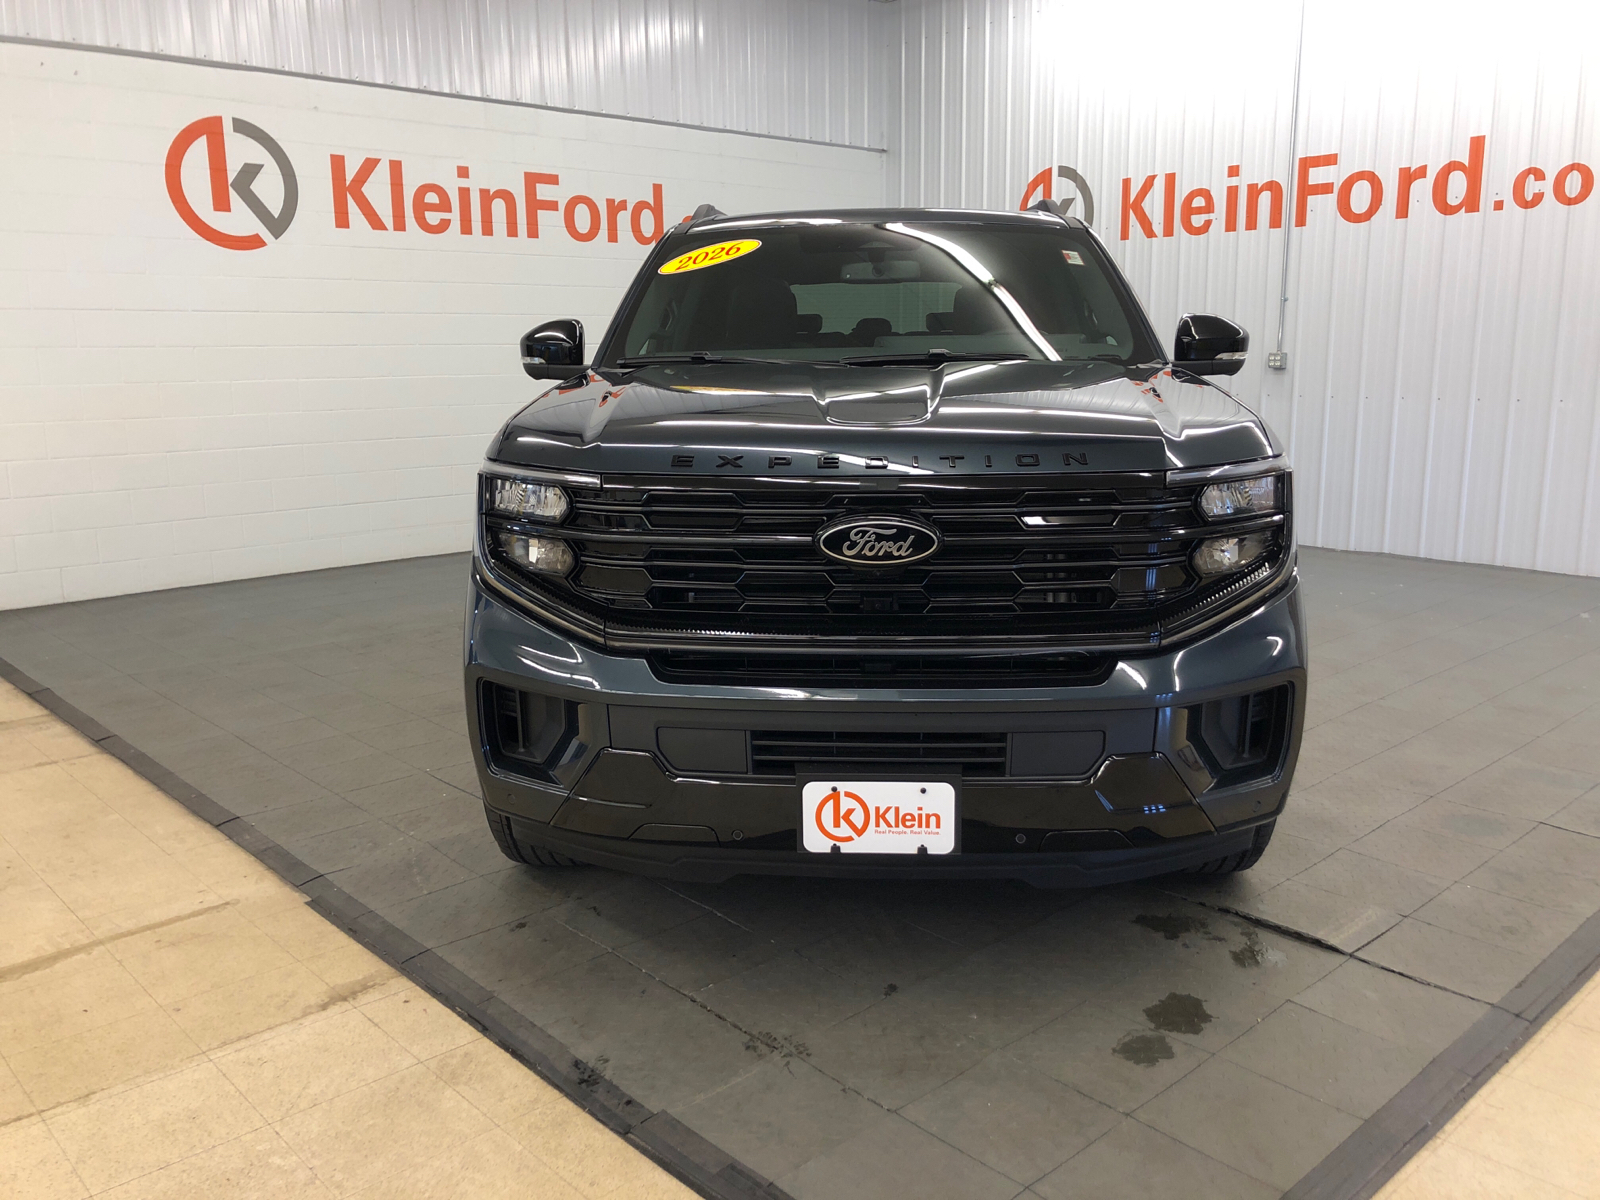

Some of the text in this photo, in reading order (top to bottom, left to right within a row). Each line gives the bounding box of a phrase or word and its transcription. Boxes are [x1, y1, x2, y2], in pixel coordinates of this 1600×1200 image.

[329, 153, 692, 246] KleinFord
[675, 242, 743, 271] 2026
[670, 453, 1090, 469] EXPEDITION
[842, 528, 915, 557] Ford
[874, 806, 941, 829] Klein
